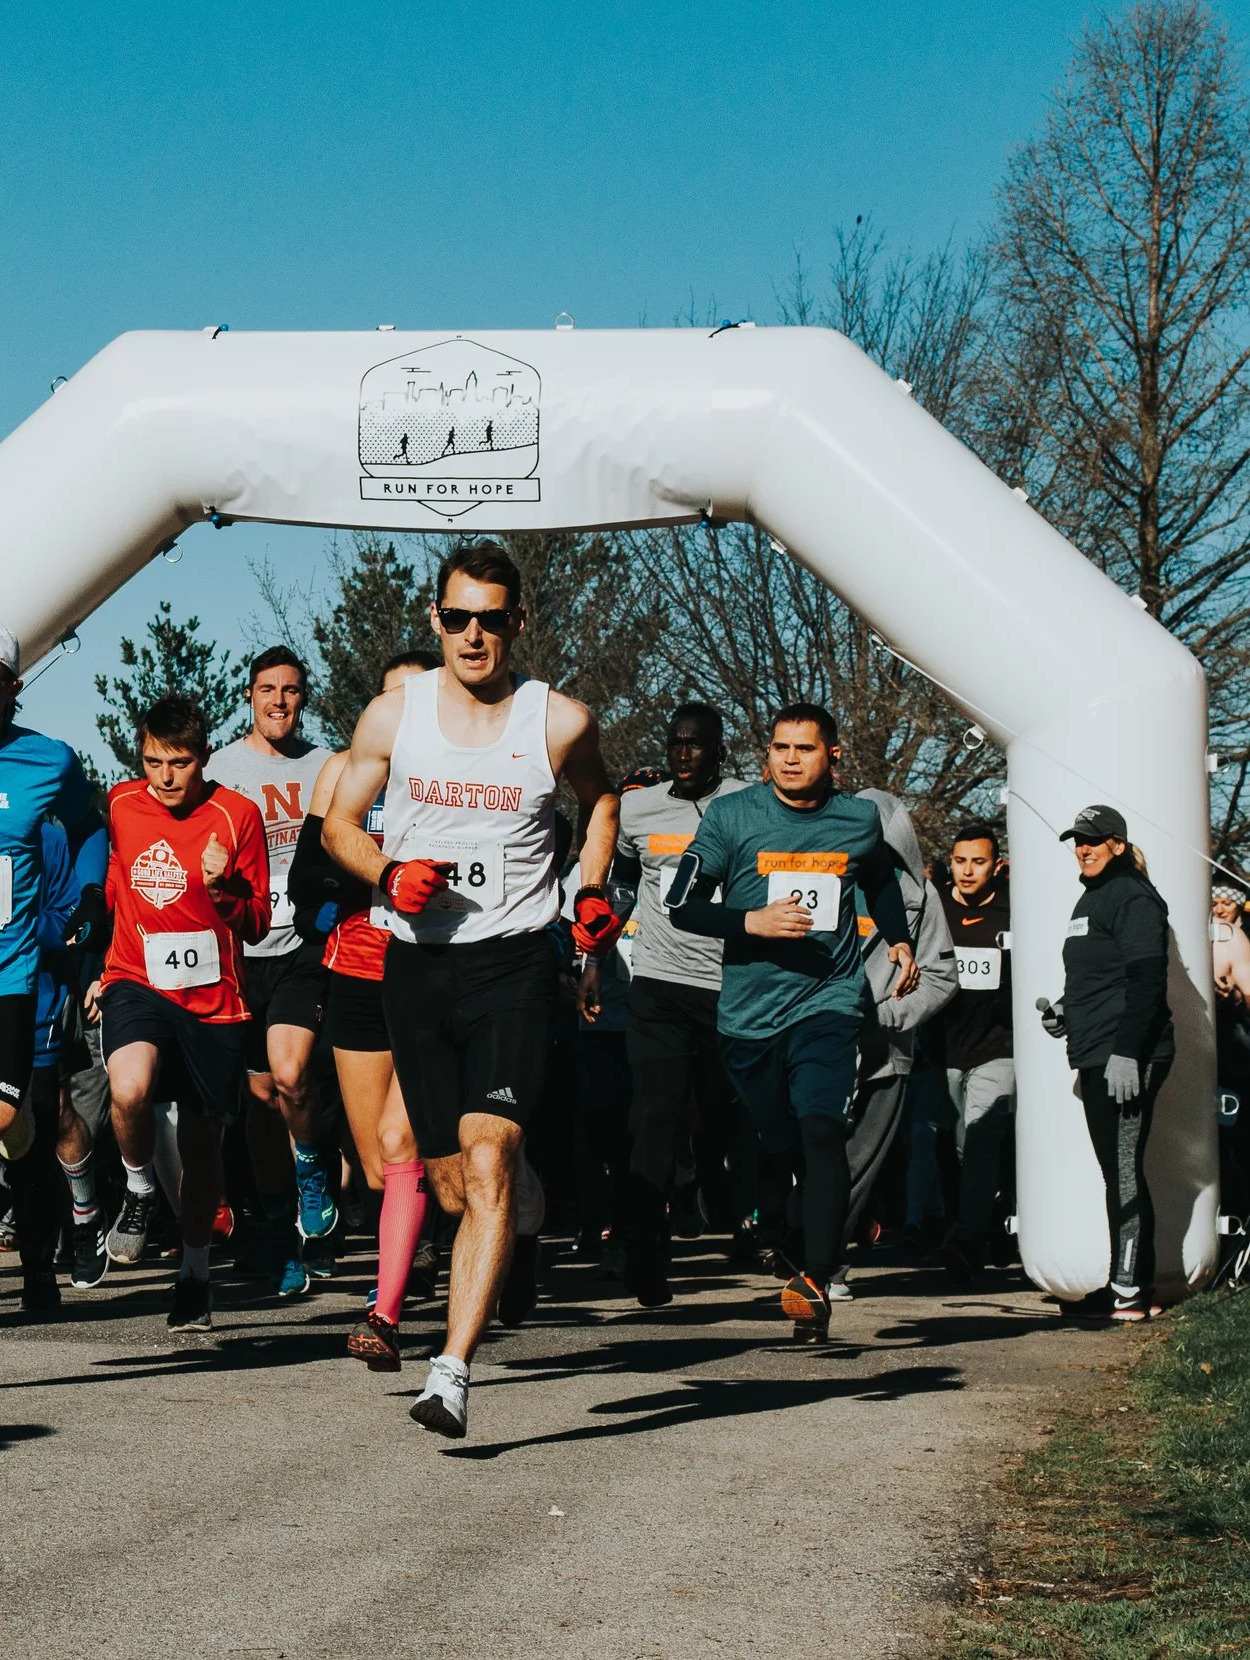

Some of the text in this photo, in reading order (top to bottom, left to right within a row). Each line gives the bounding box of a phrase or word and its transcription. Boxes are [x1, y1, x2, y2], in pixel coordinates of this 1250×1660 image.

[384, 484, 514, 495] RUN FOR HOPE
[260, 782, 304, 821] N
[409, 777, 522, 812] DARTON
[267, 829, 302, 849] TINA
[765, 859, 786, 869] run
[790, 855, 807, 868] for
[165, 948, 198, 969] 40
[957, 959, 991, 975] 303
[486, 1093, 517, 1105] adidas
